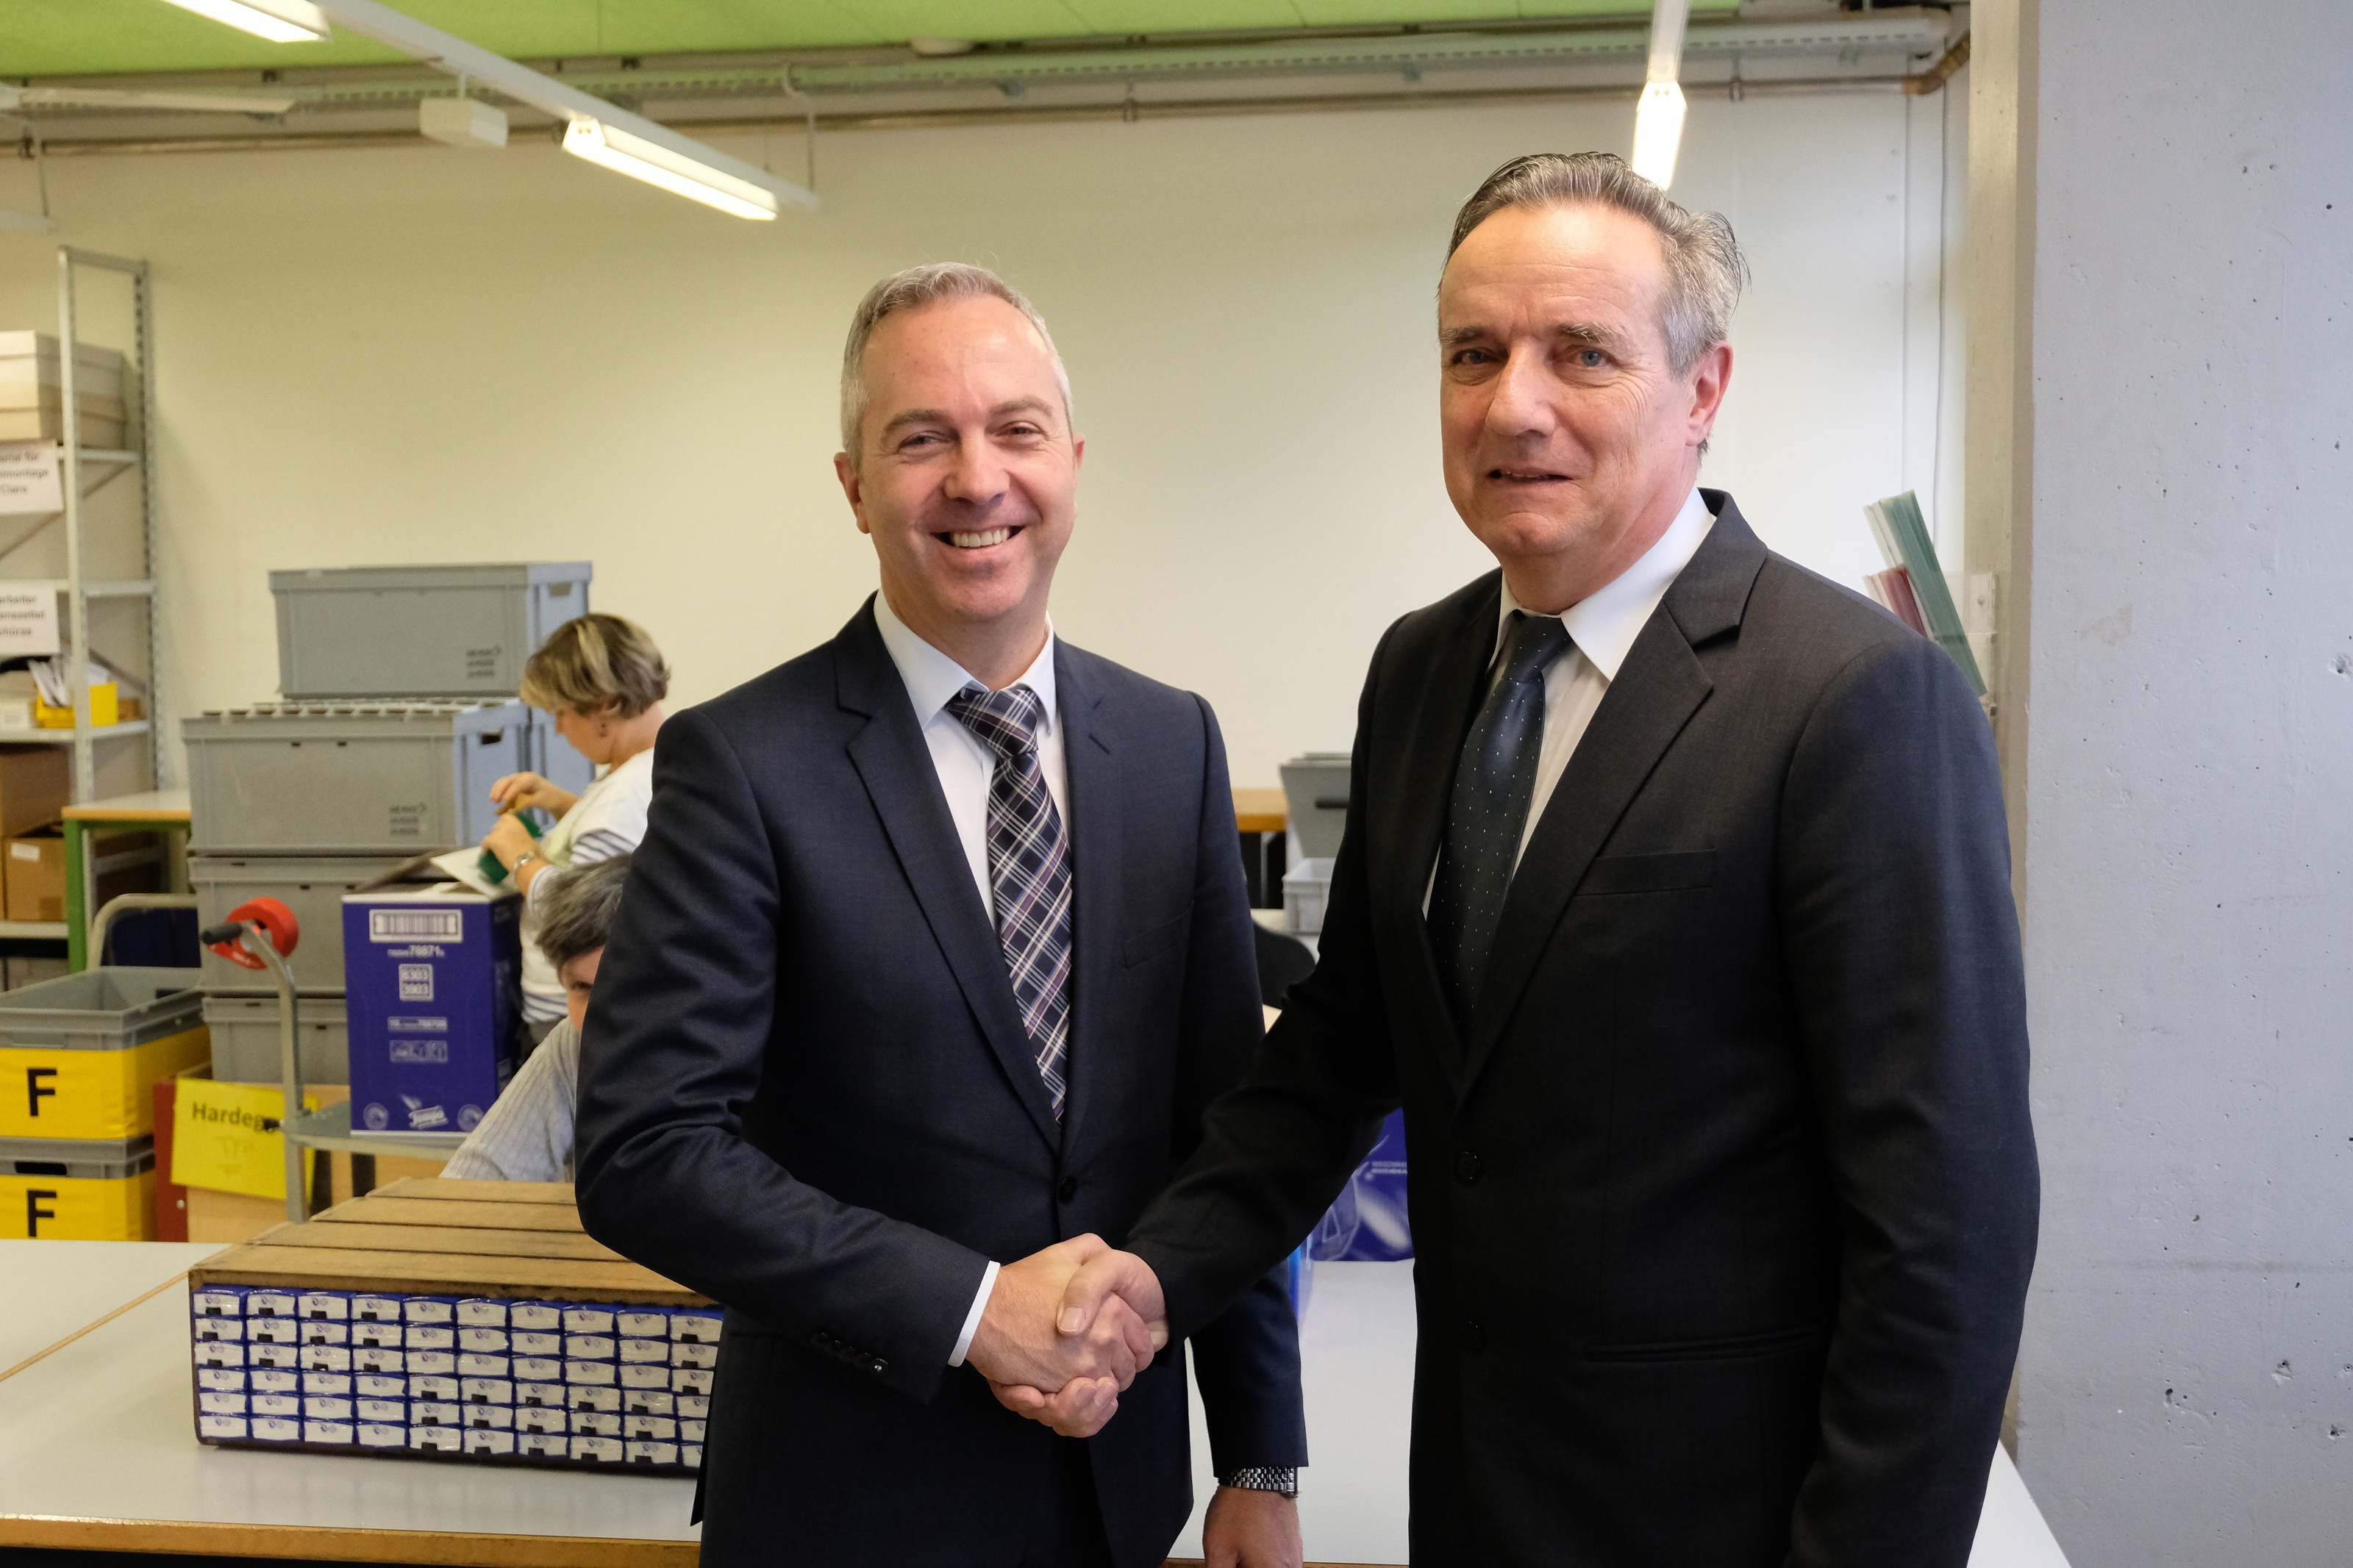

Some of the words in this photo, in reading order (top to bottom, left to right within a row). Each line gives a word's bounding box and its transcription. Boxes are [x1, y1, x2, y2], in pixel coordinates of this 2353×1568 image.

[27, 1067, 58, 1117] F
[193, 1102, 276, 1134] Hardeg
[27, 1190, 57, 1238] F
